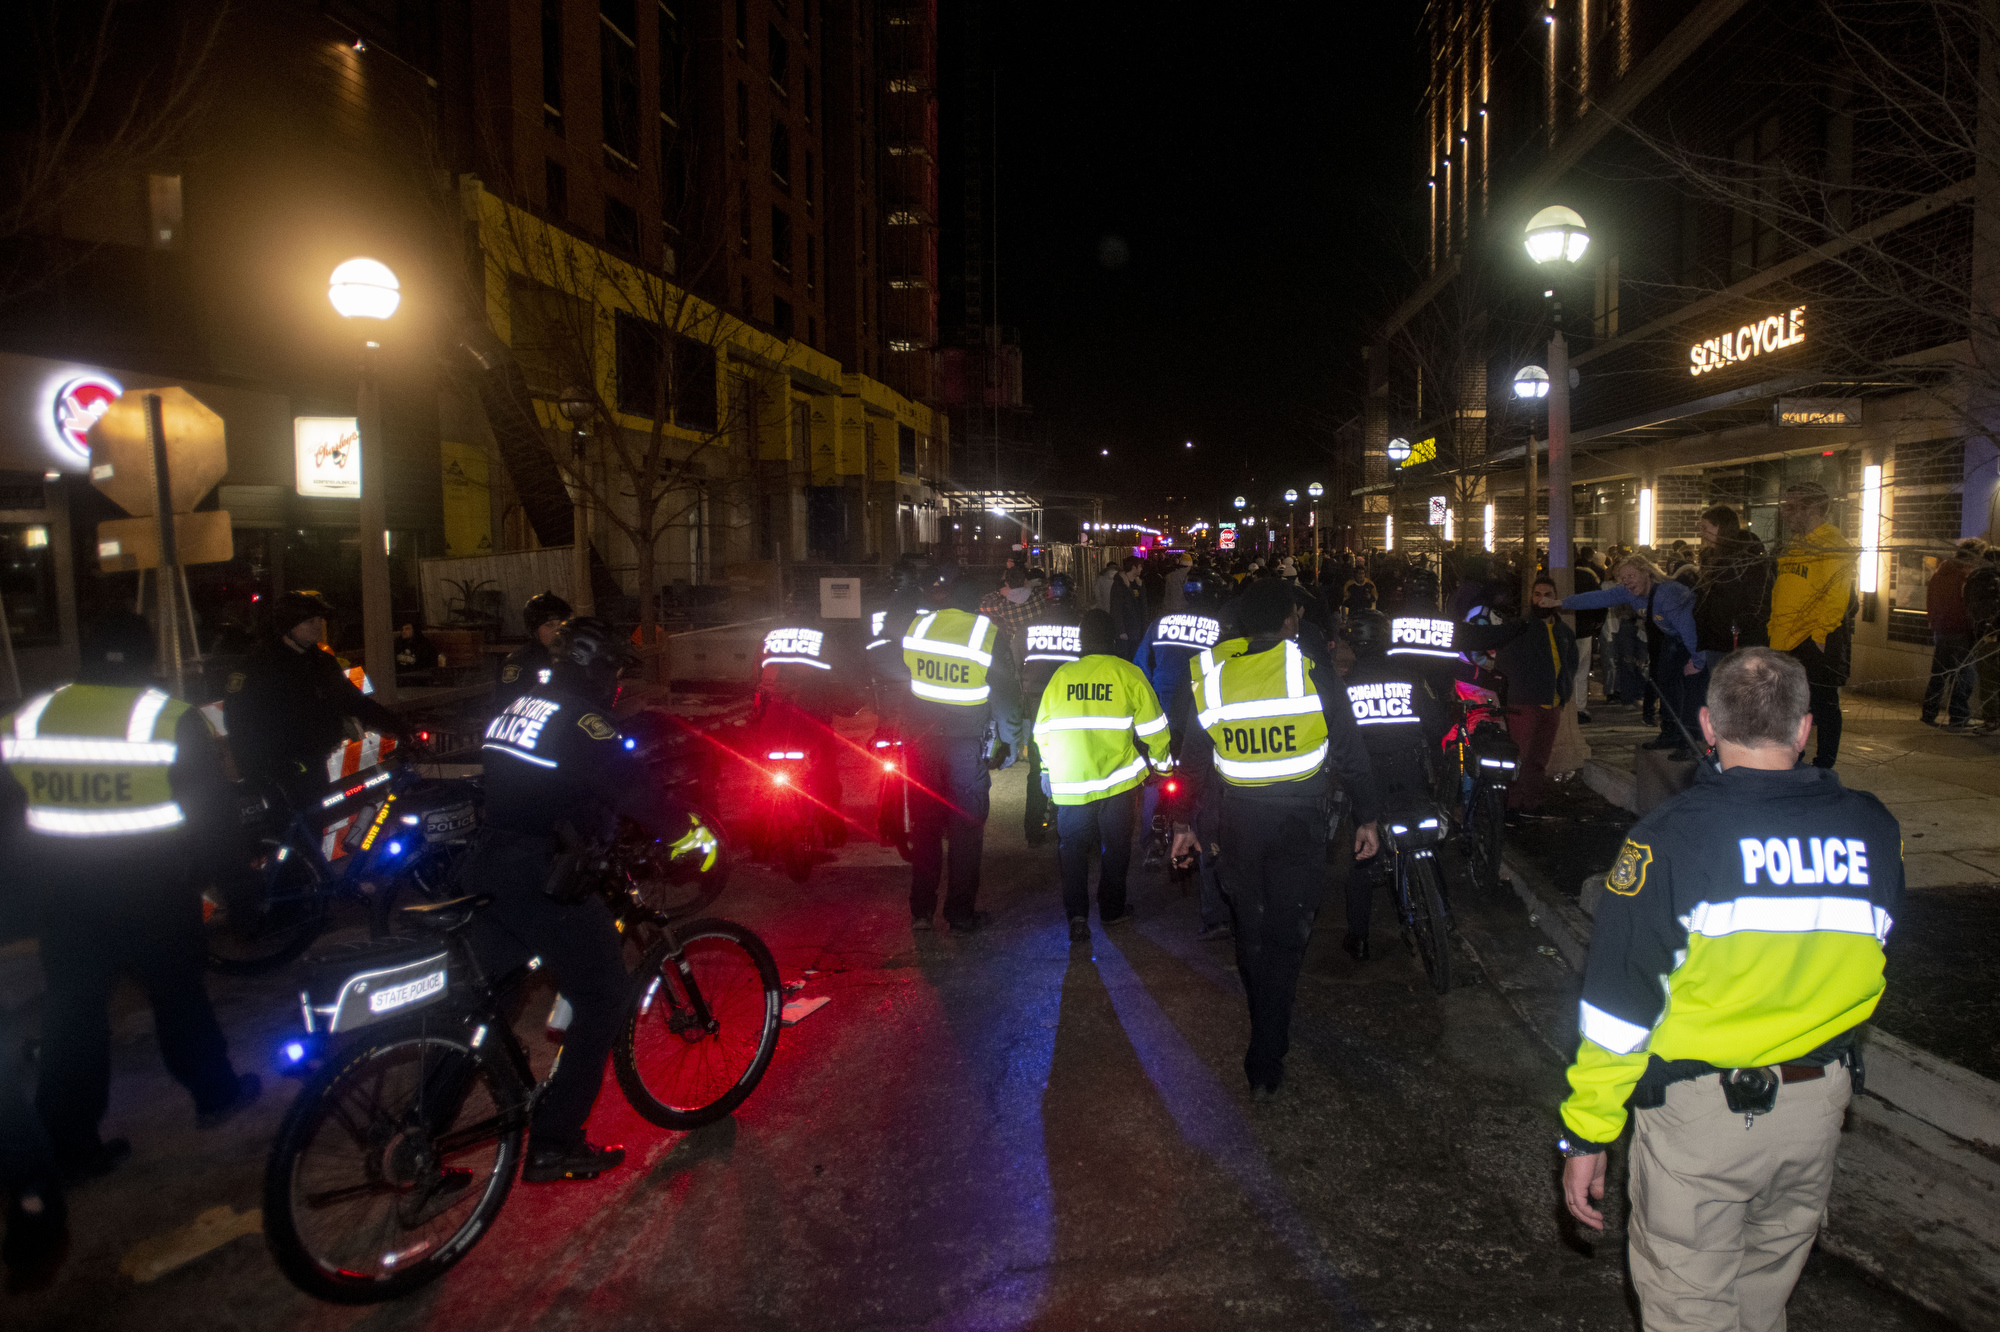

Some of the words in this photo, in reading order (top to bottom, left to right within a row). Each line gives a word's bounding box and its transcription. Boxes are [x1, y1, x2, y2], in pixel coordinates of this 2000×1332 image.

[1690, 305, 1806, 376] SOULCYCLE
[1781, 412, 1846, 424] SOULCYCLE
[798, 628, 823, 643] STATE
[1062, 626, 1080, 638] STAT
[1158, 624, 1219, 646] POLICE
[1431, 619, 1454, 633] STATE
[764, 639, 820, 656] POLICE
[1027, 636, 1082, 652] POLICE
[1392, 628, 1453, 648] POLICE
[917, 658, 969, 683] POLICE
[1067, 683, 1113, 701] POLICE
[1347, 683, 1384, 702] CHIGAN
[1384, 682, 1412, 699] STATE
[1352, 698, 1413, 718] OLICE
[1223, 725, 1297, 754] POLICE
[31, 771, 132, 802] POLICE
[323, 793, 344, 807] STATE
[364, 772, 391, 788] POLICE
[427, 813, 476, 833] POLICE
[361, 824, 380, 851] STATE
[1739, 838, 1869, 886] POLICE
[376, 987, 408, 1006] STATE
[409, 975, 440, 998] POLICE
